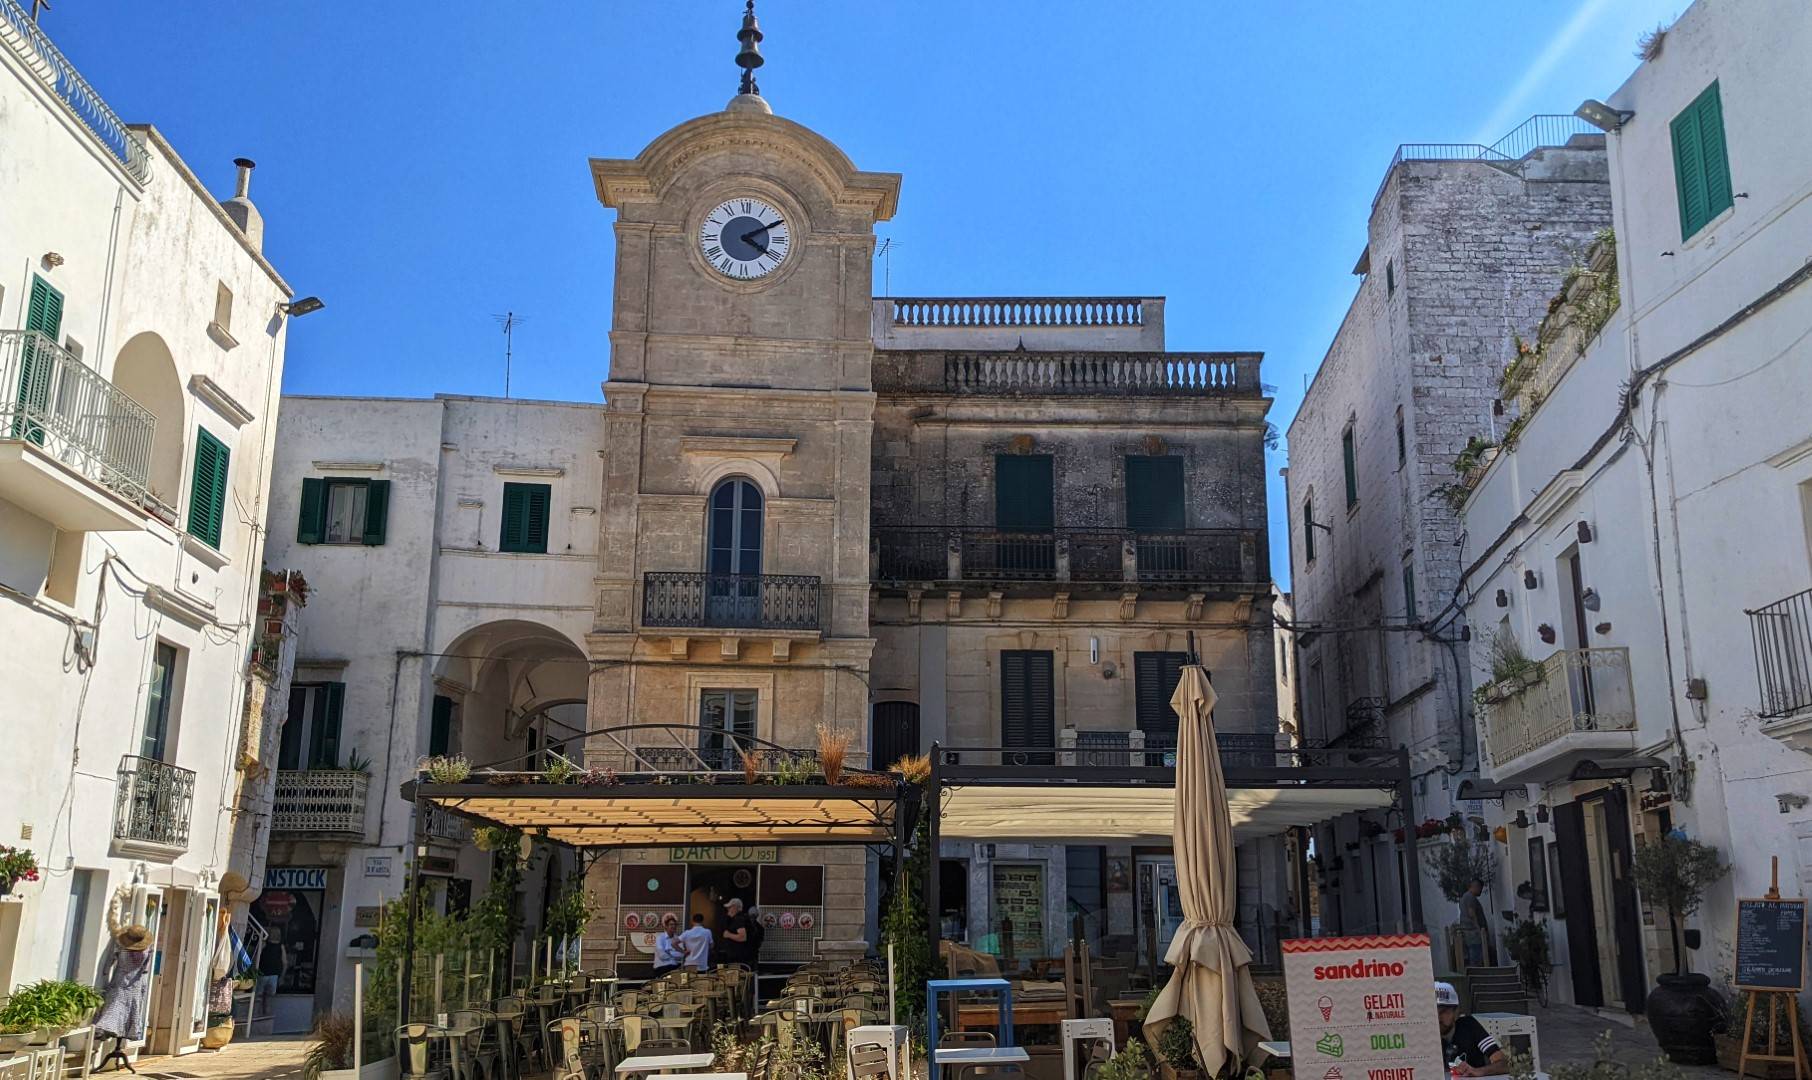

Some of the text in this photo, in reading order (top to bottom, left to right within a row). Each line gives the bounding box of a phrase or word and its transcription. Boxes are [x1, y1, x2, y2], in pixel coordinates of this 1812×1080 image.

[757, 850, 775, 860] 1951
[1313, 959, 1404, 980] sandrino
[1363, 993, 1404, 1010] GELATI
[1375, 1010, 1406, 1020] NATURALE
[1370, 1033, 1406, 1050] DOLCI
[1367, 1067, 1414, 1080] YOGURT
